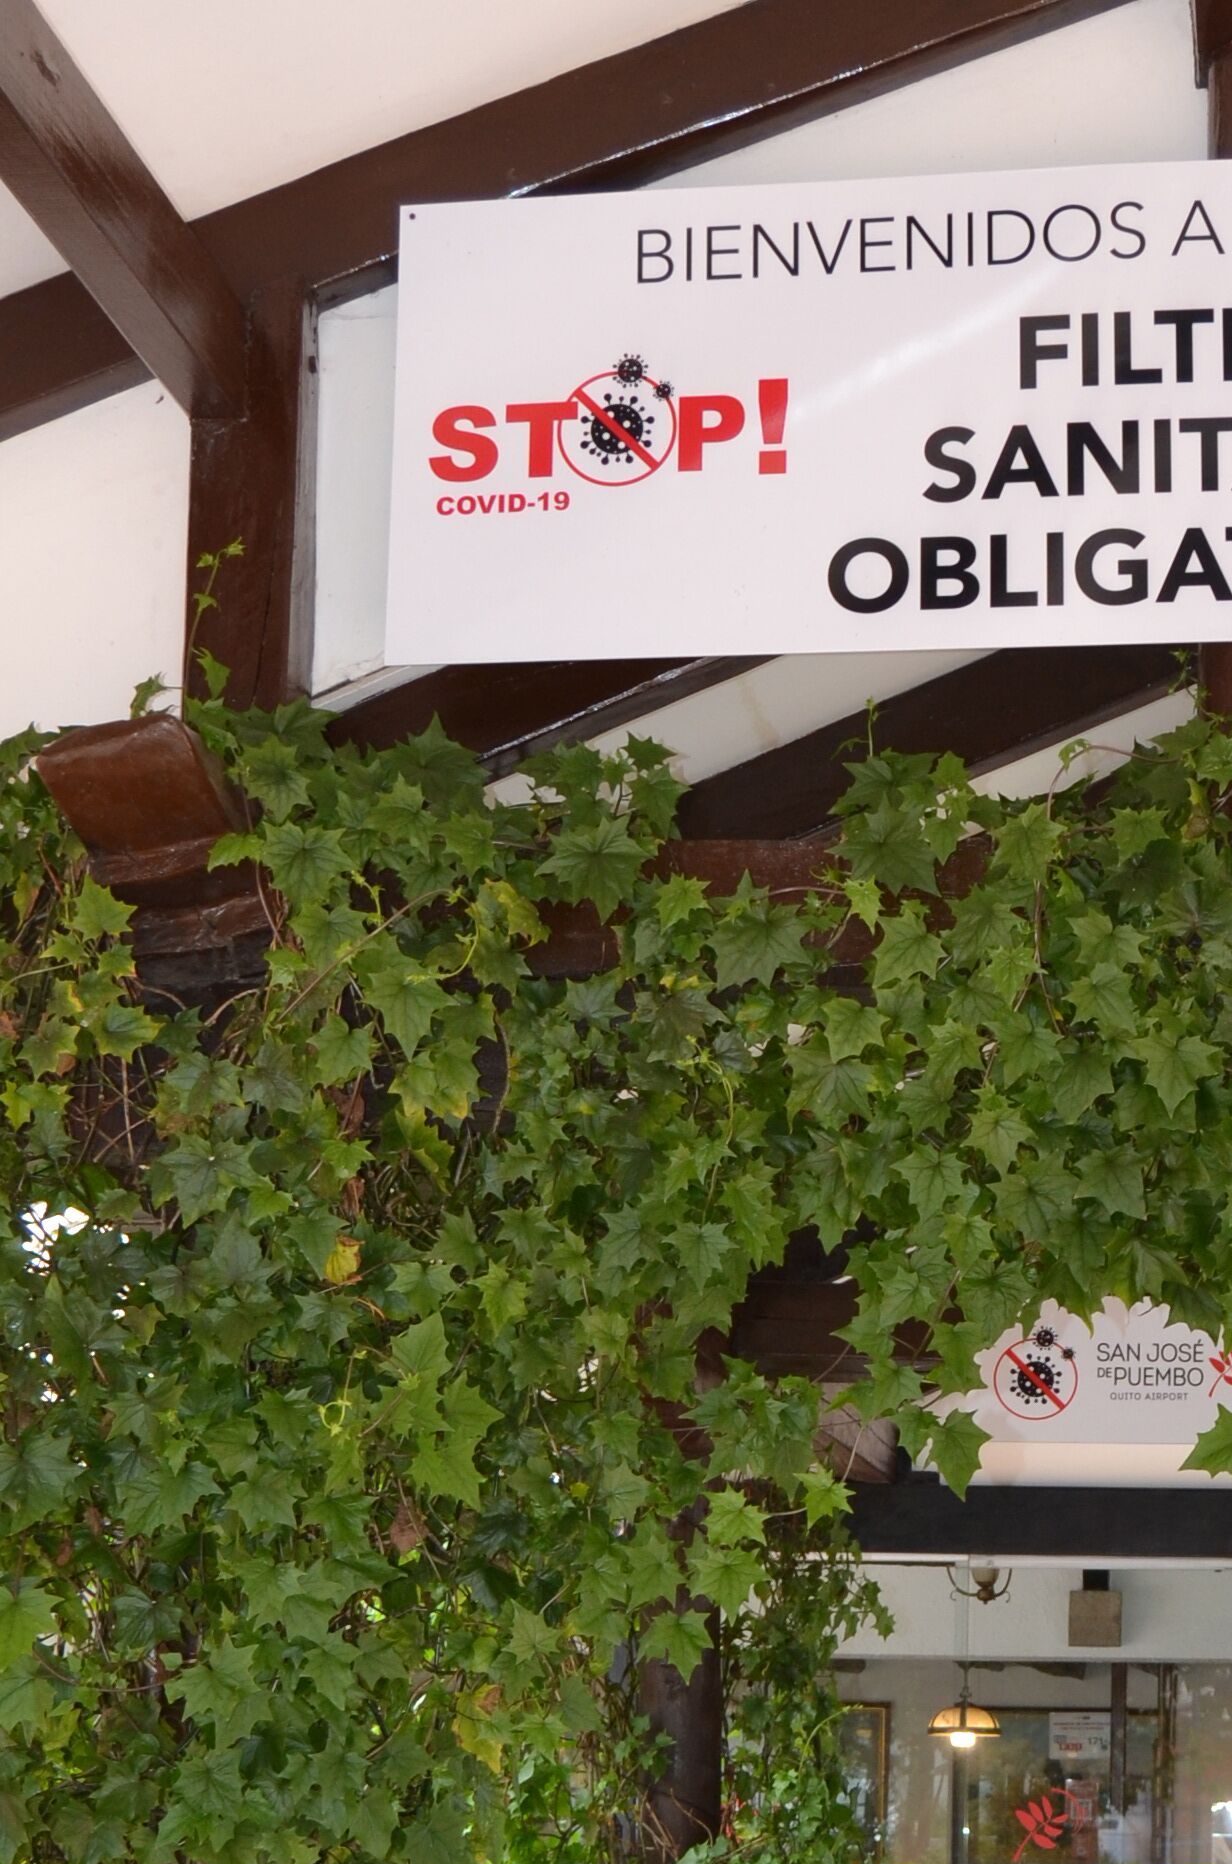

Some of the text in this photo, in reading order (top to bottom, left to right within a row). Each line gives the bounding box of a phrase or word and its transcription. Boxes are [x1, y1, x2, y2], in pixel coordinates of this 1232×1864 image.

[637, 199, 1225, 285] BIENVENIDOS A
[436, 490, 571, 517] COVID-19
[1096, 1339, 1204, 1363] SAN JOSÉ
[1096, 1366, 1205, 1387] DE PUEMBO
[1110, 1392, 1189, 1401] QUITO AIRPORT
